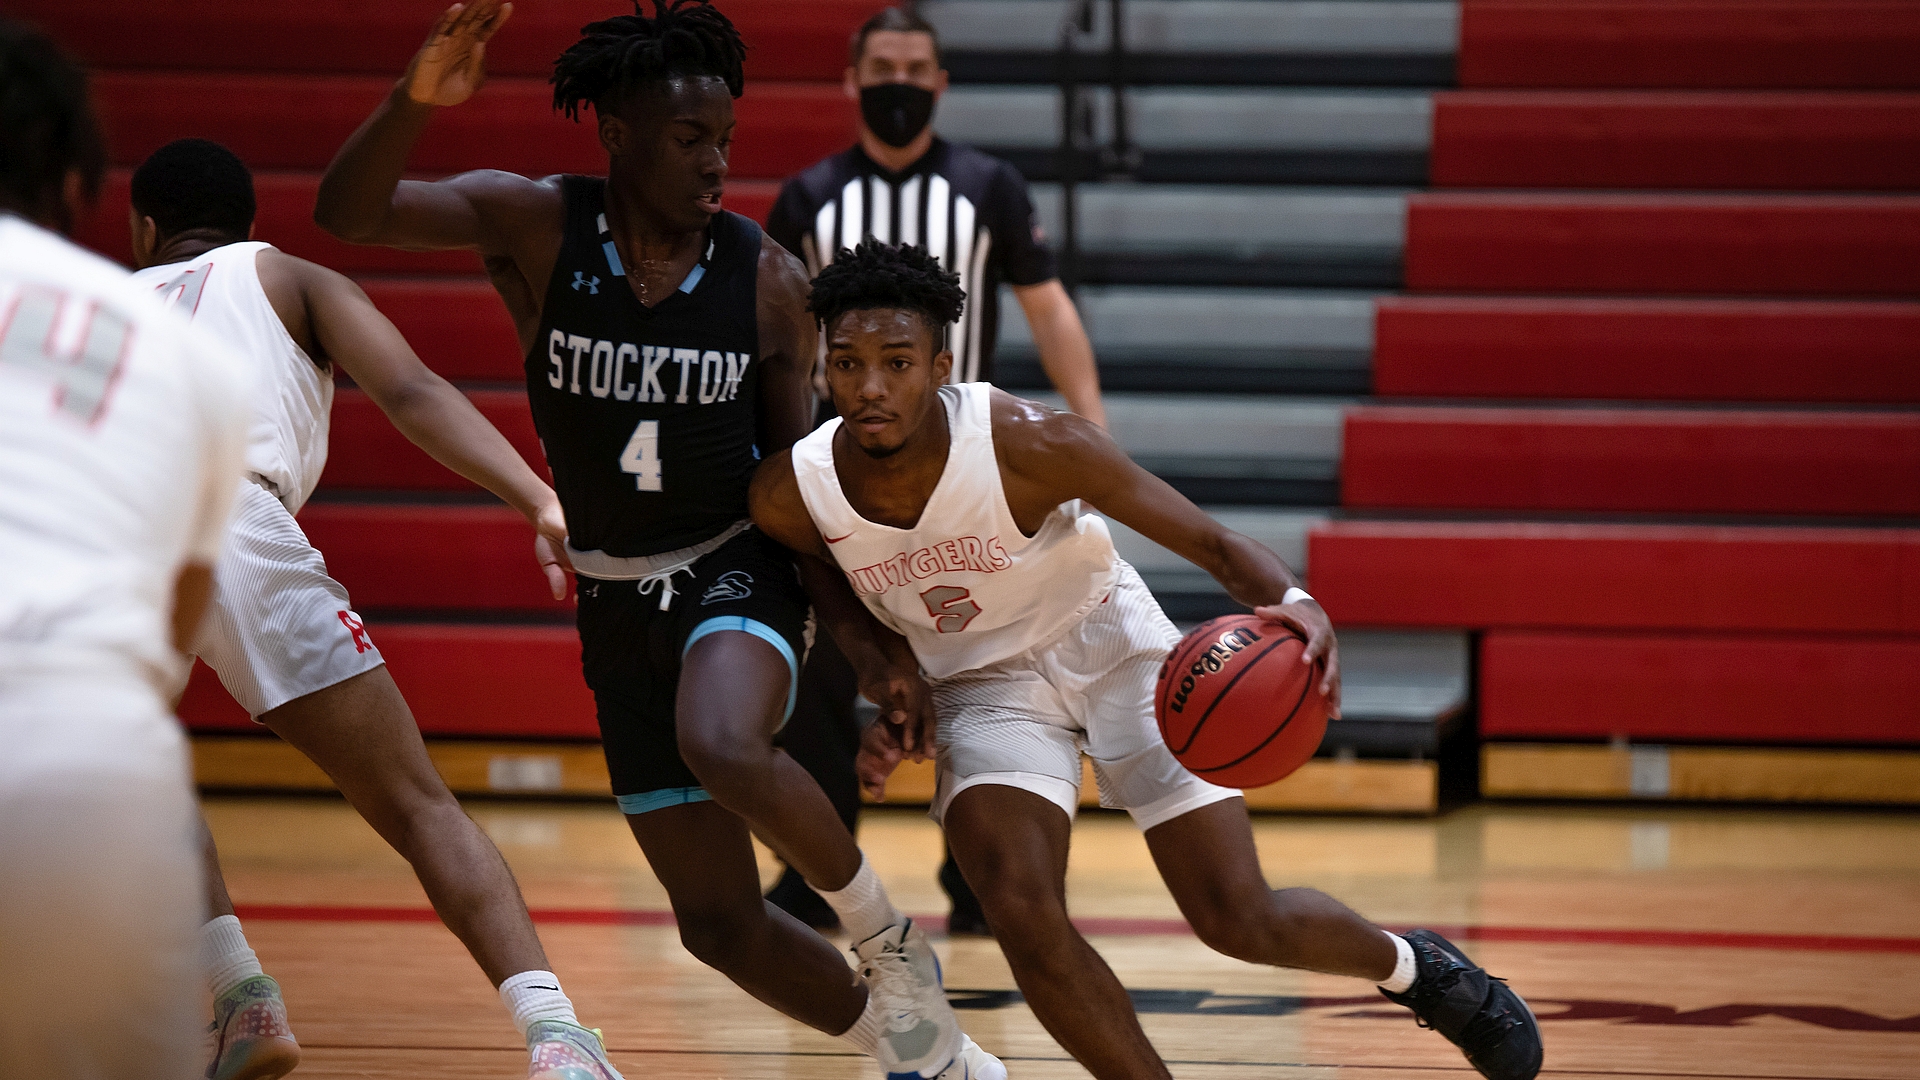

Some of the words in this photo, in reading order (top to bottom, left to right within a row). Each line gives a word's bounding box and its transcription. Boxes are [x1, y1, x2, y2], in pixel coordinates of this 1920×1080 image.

[547, 327, 752, 405] STOCKTON
[618, 419, 664, 493] 4
[919, 584, 983, 634] 5
[1171, 626, 1264, 714] Wilson
